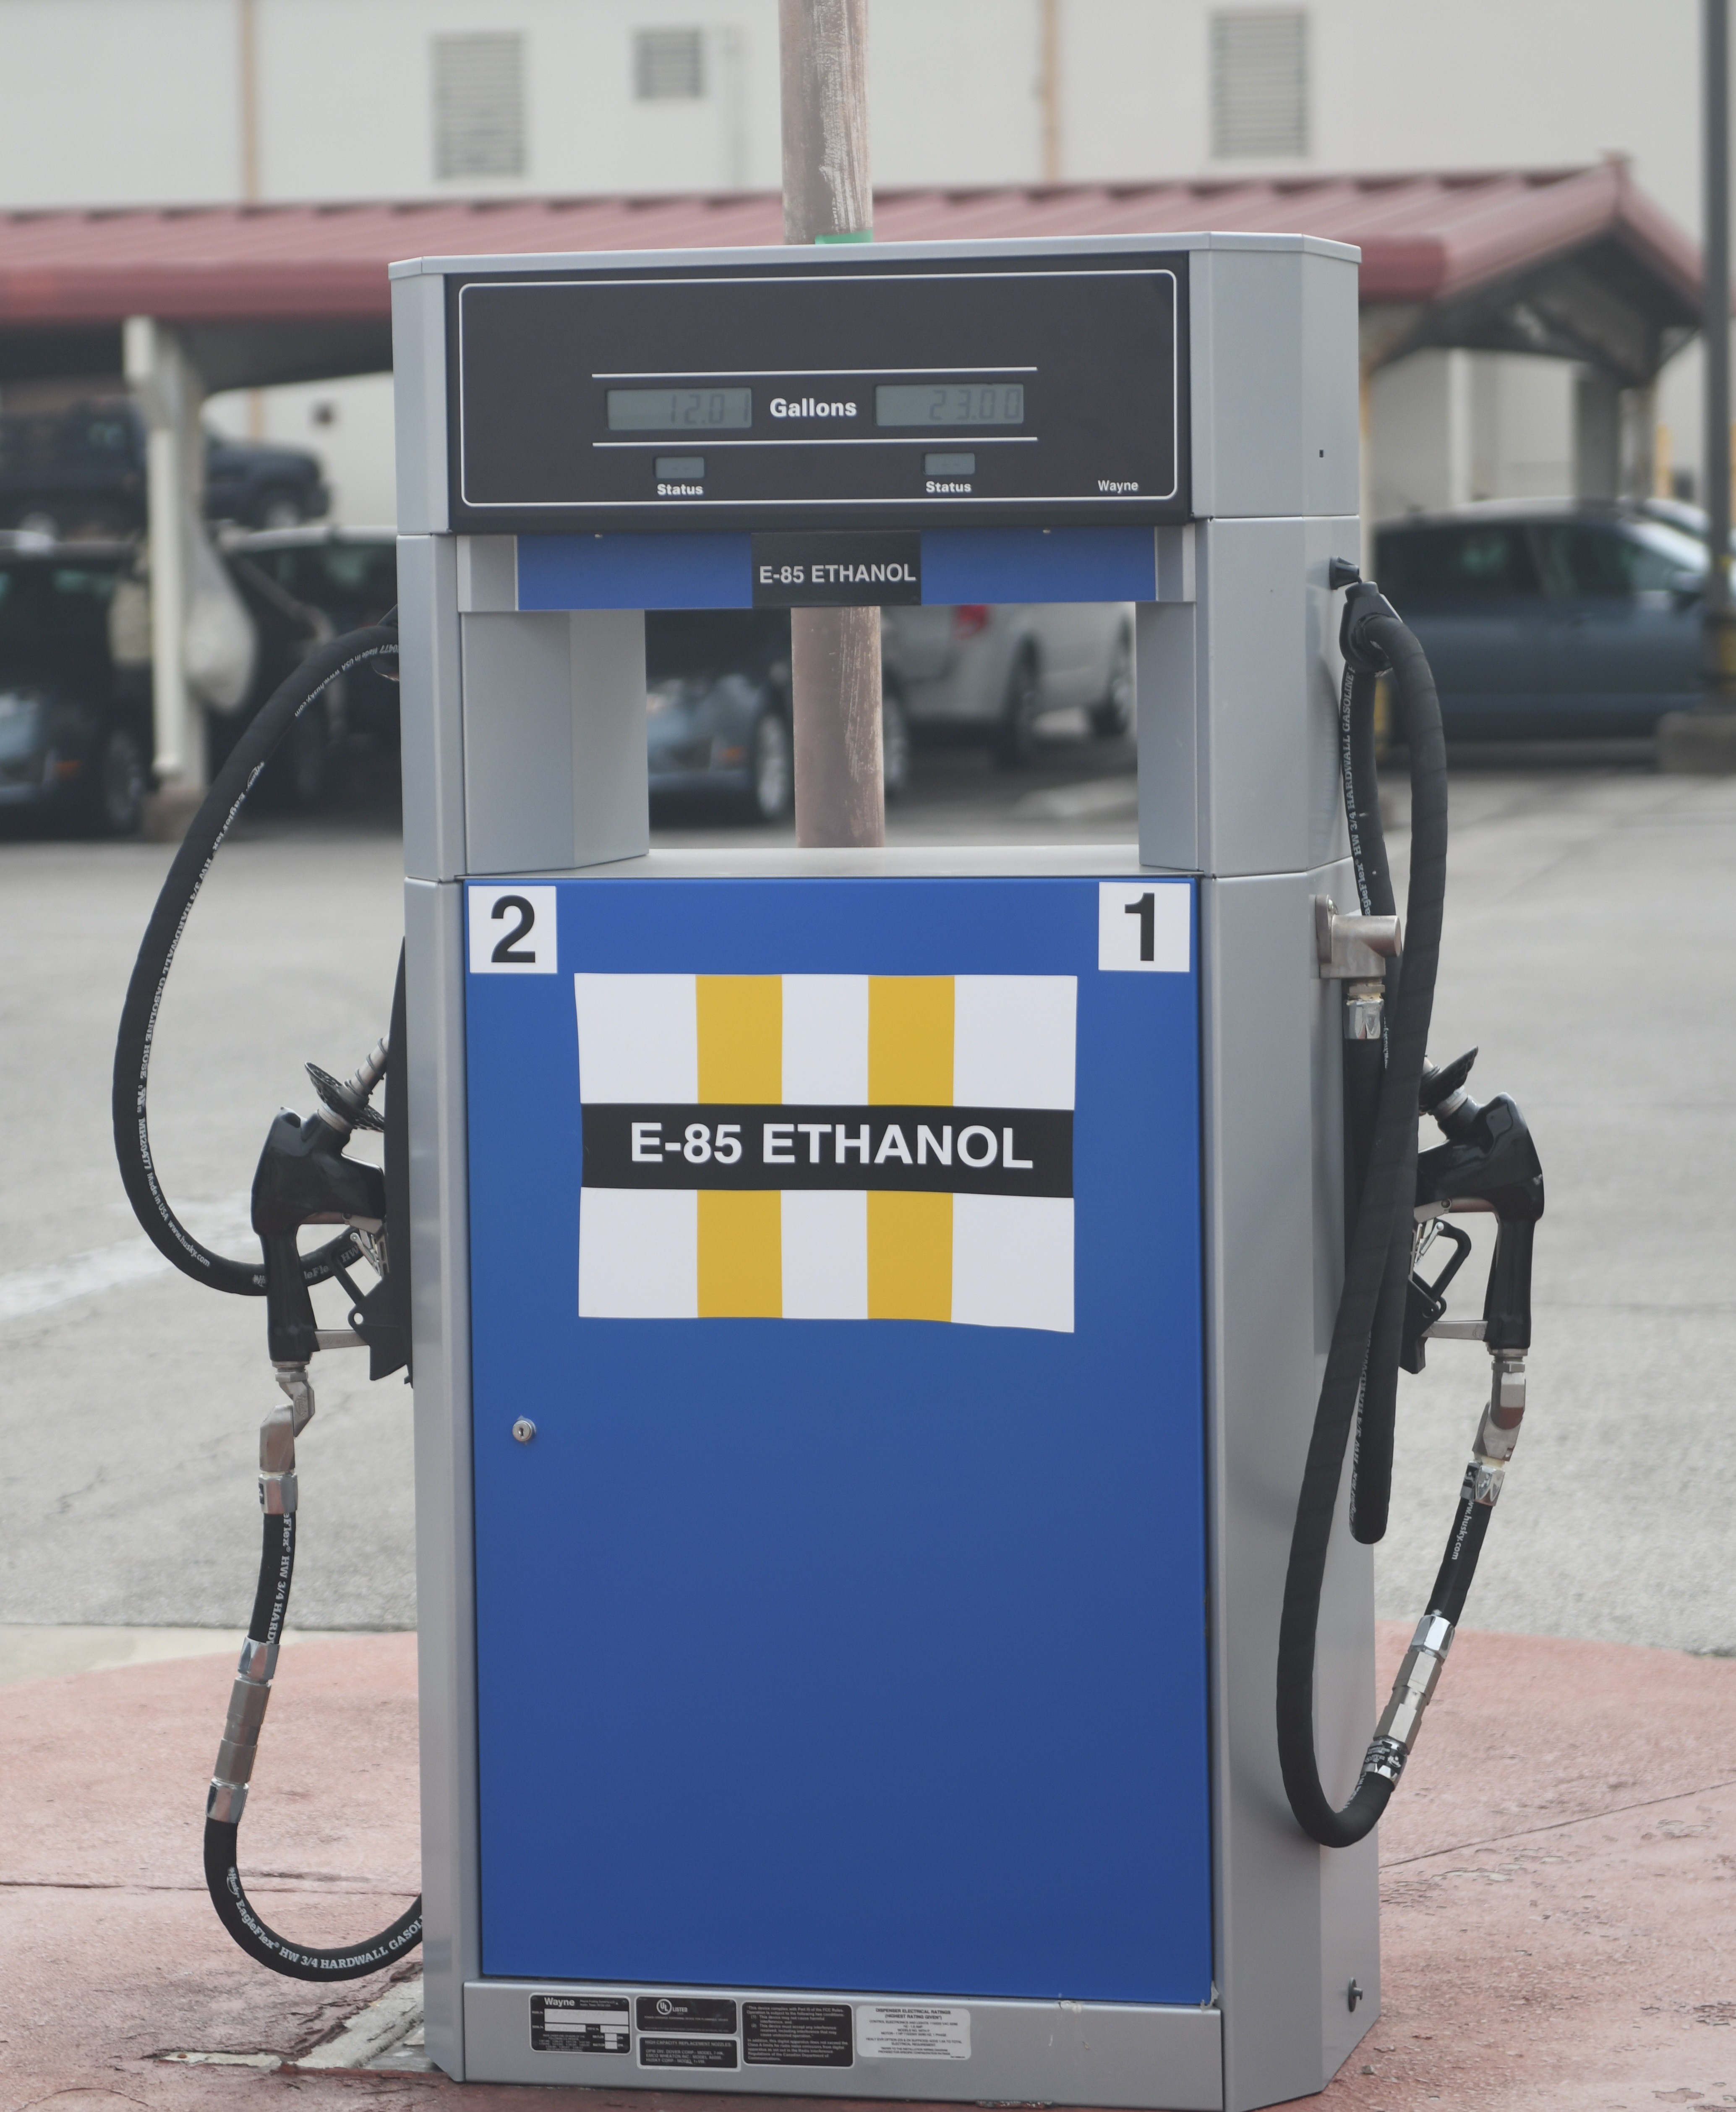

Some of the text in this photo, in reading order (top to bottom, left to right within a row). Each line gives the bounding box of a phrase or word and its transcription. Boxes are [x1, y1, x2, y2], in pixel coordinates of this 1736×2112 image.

[770, 398, 857, 418] Gallons
[929, 389, 1021, 421] 23.00
[657, 483, 703, 497] Status
[925, 480, 971, 493] Status
[1097, 479, 1139, 493] Wayne
[760, 563, 916, 583] E-85 ETHANOL
[362, 647, 378, 658] Made
[379, 644, 399, 654] 0477
[341, 658, 355, 671] USA
[294, 669, 340, 718] www.husky.com
[1343, 672, 1354, 732] GASOLINE
[1343, 735, 1355, 810] HARDWALL
[1349, 811, 1357, 831] 3/4
[1351, 834, 1361, 856] HW
[198, 857, 212, 881] HW
[189, 881, 201, 901] 3/4
[162, 901, 192, 975] HARDWALL
[490, 893, 538, 964] 2
[1124, 892, 1155, 962] 1
[145, 976, 166, 1043] GASOLINE
[139, 1043, 150, 1080] HOSE
[631, 1122, 1034, 1170] E-85 ETHANOL
[138, 1117, 151, 1169] MH20477
[146, 1172, 157, 1197] Made
[154, 1194, 161, 1205] in
[159, 1204, 169, 1222] USA
[167, 1220, 210, 1267] www.husky.com
[1451, 1499, 1474, 1561] ww.husky.com
[279, 1555, 290, 1579] HW
[275, 1580, 286, 1600] 3/4
[266, 1601, 282, 1645] HARD
[279, 1946, 300, 1963] HW
[300, 1956, 318, 1968] 3/4
[320, 1946, 389, 1969] HARDWALL
[544, 1997, 576, 2008] Wayne
